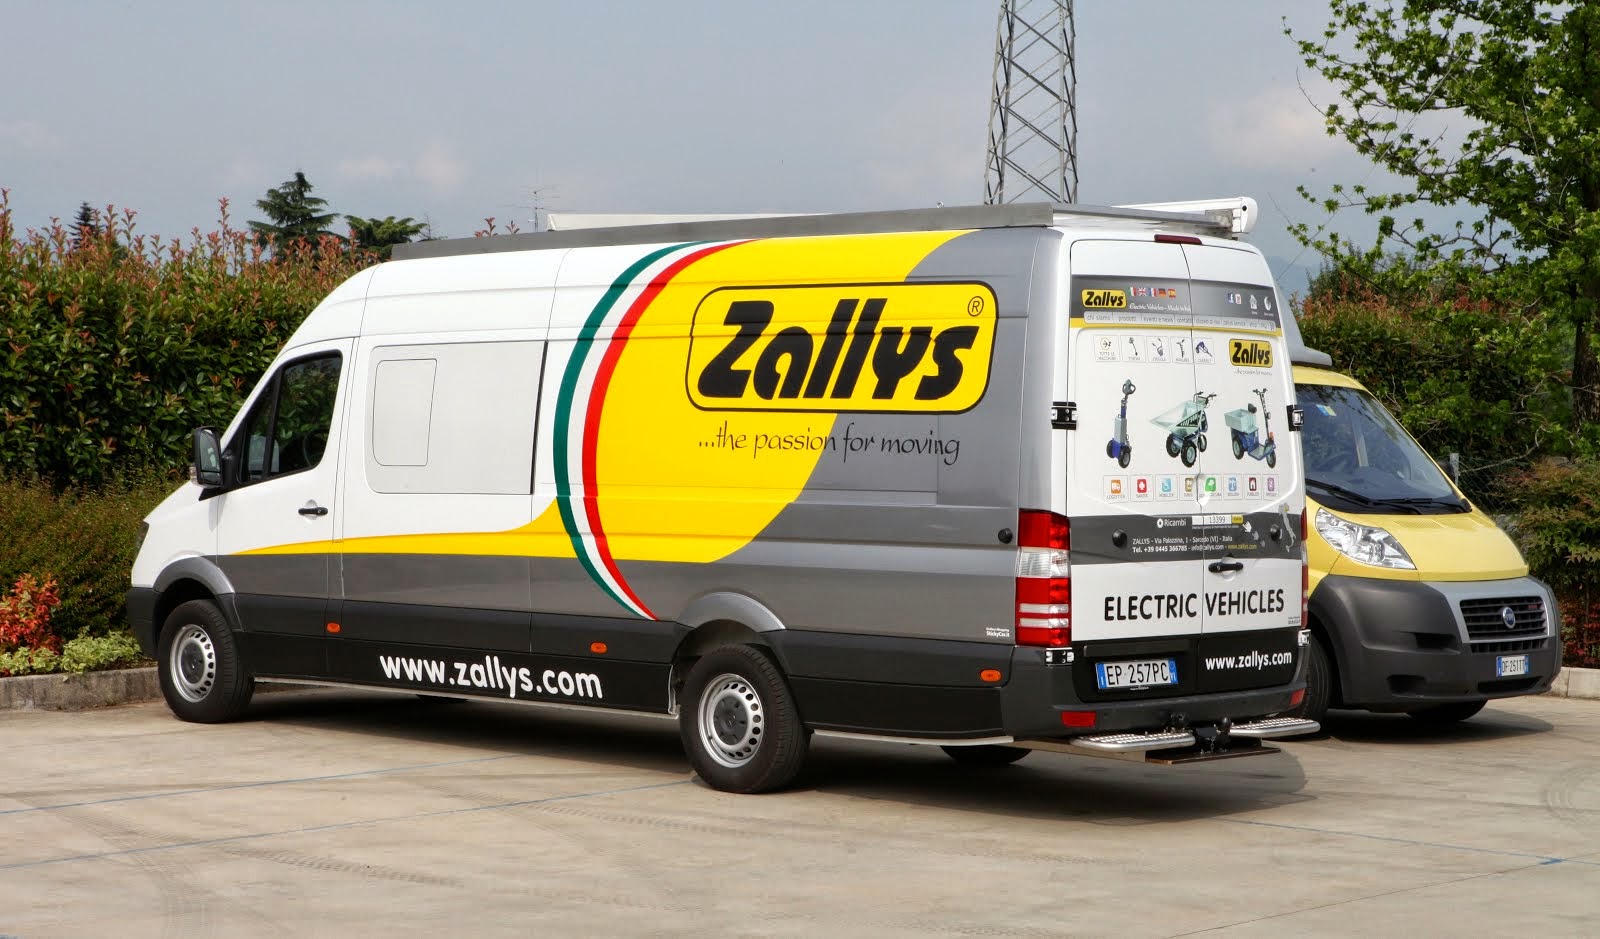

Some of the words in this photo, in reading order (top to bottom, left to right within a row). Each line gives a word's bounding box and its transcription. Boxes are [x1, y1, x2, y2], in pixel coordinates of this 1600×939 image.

[1084, 291, 1124, 307] Zallys
[697, 298, 980, 400] Zallys
[1232, 342, 1270, 365] Zallys
[753, 427, 837, 459] passion
[843, 422, 875, 463] for
[880, 430, 960, 465] moving
[1164, 518, 1187, 527] Ricambi
[1104, 593, 1198, 621] ELECTRIC
[1205, 589, 1285, 617] VEHICLES
[1205, 651, 1292, 671] www.zallys.com
[379, 655, 603, 699] www.zallys.com
[1106, 665, 1122, 686] EP
[1128, 662, 1169, 684] 257PC
